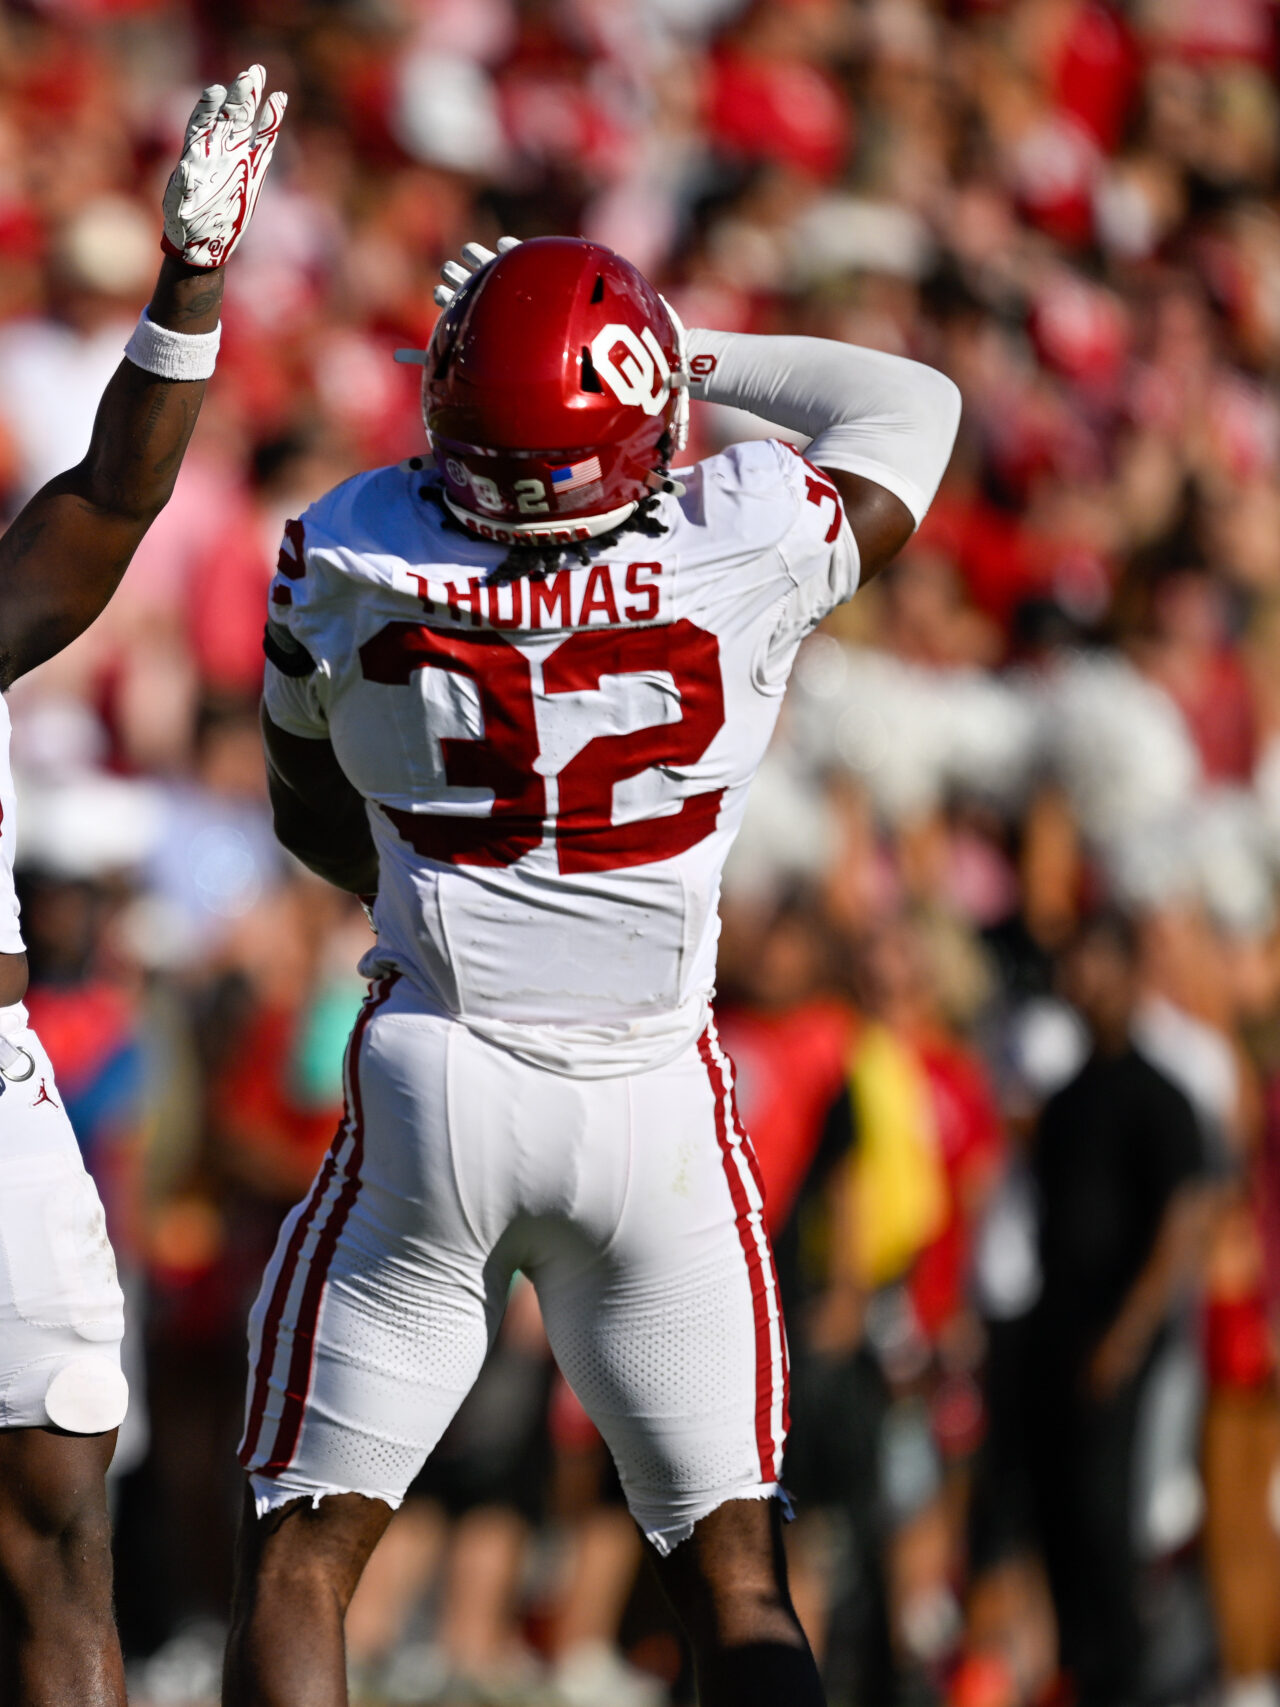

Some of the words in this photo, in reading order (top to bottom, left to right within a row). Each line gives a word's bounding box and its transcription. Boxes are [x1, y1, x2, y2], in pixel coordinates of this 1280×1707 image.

[591, 323, 671, 416] OU
[406, 561, 663, 630] THOMAS
[360, 619, 725, 875] 32
